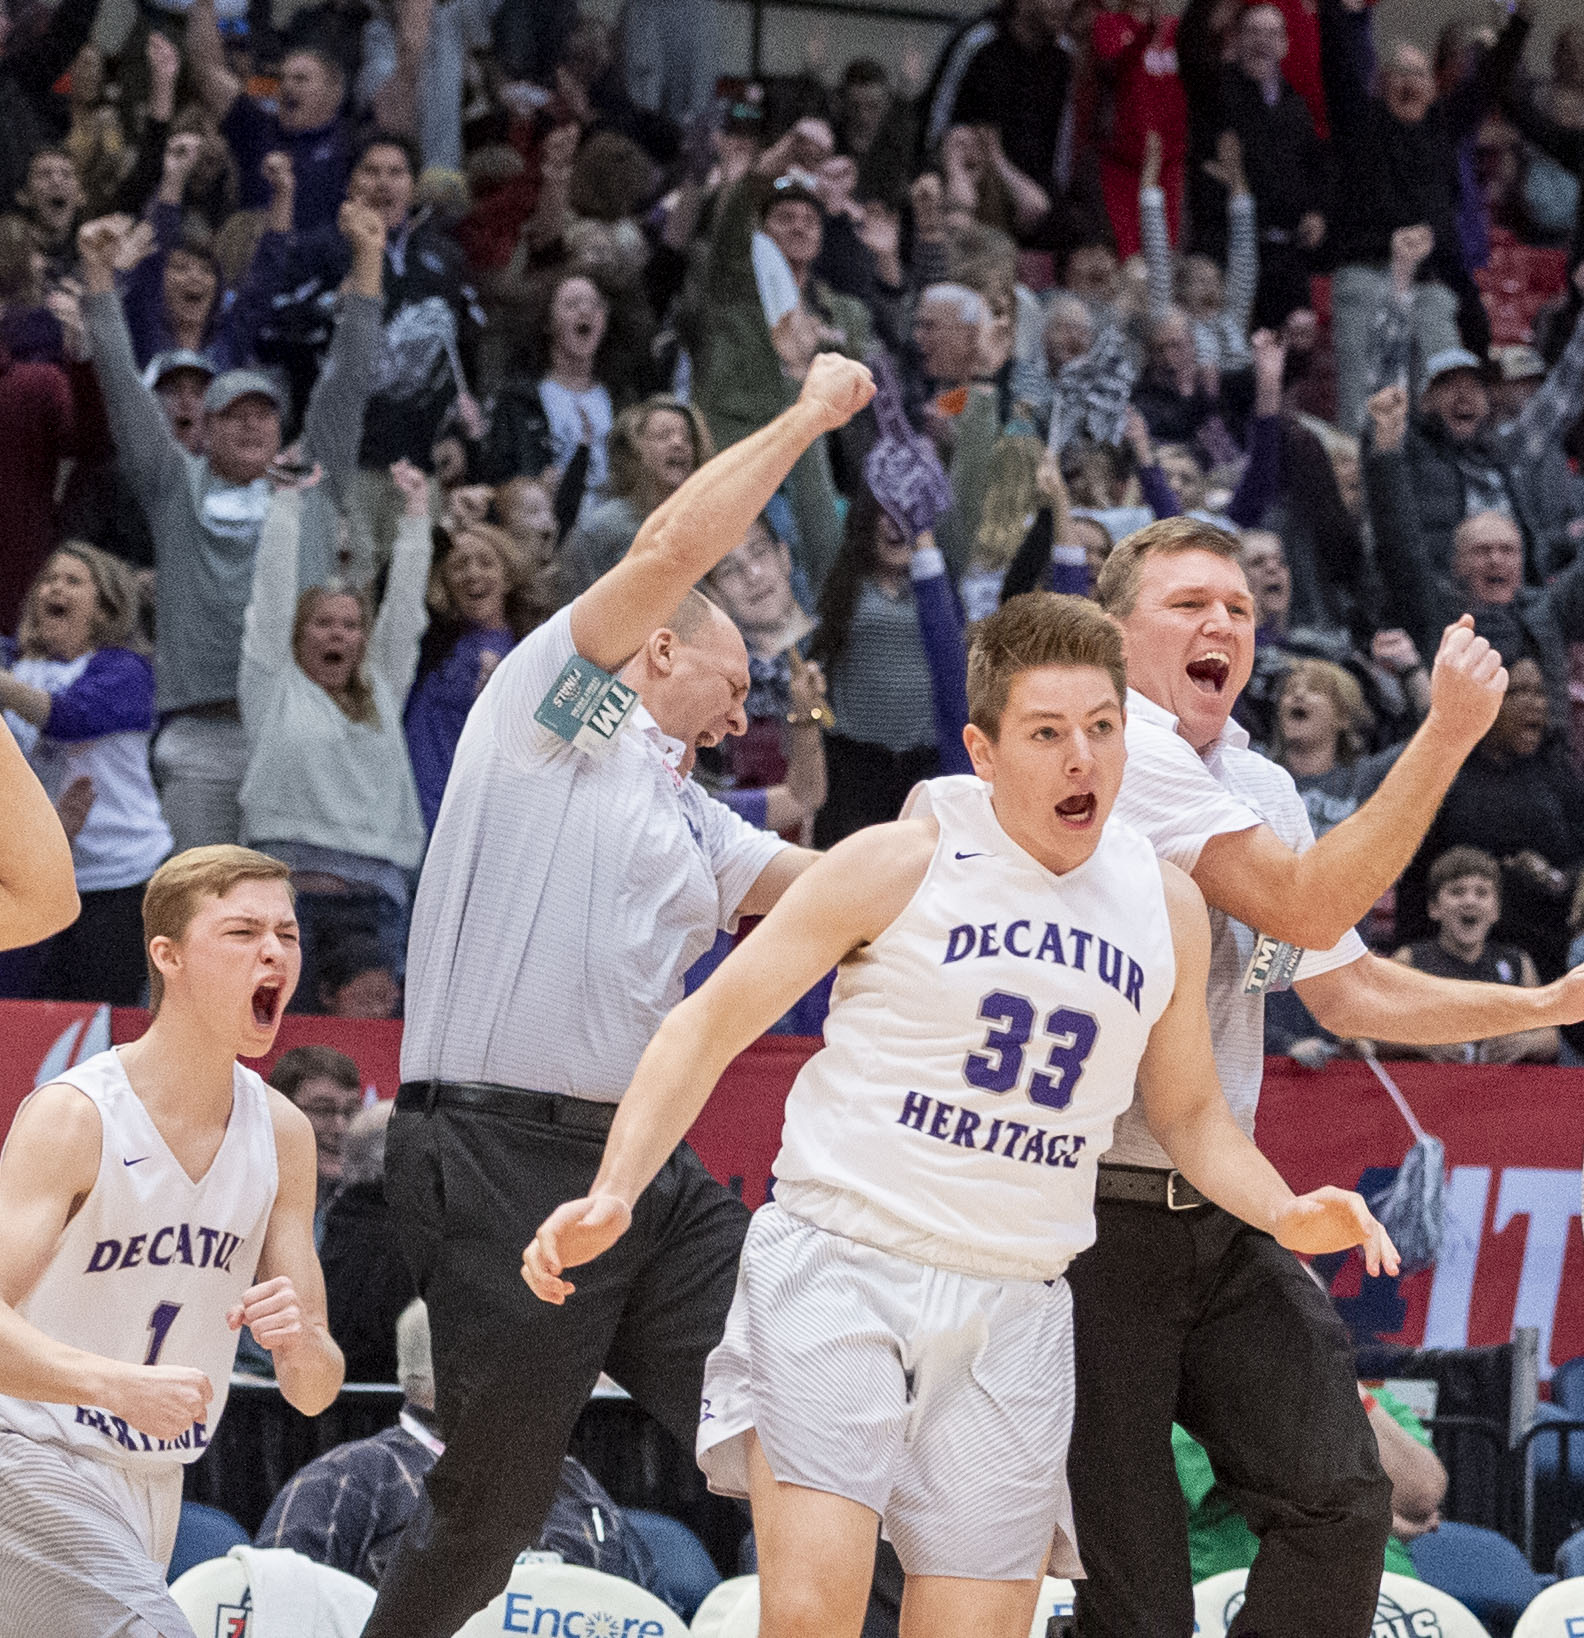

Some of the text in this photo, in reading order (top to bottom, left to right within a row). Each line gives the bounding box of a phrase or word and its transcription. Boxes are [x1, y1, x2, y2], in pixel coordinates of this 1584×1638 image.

[590, 685, 635, 738] TM
[940, 918, 1145, 1016] DECATUR
[1246, 940, 1278, 989] TM
[960, 987, 1102, 1113] 33
[896, 1090, 1087, 1169] HERITAGE
[84, 1222, 245, 1276] DECATU
[142, 1300, 184, 1367] 1
